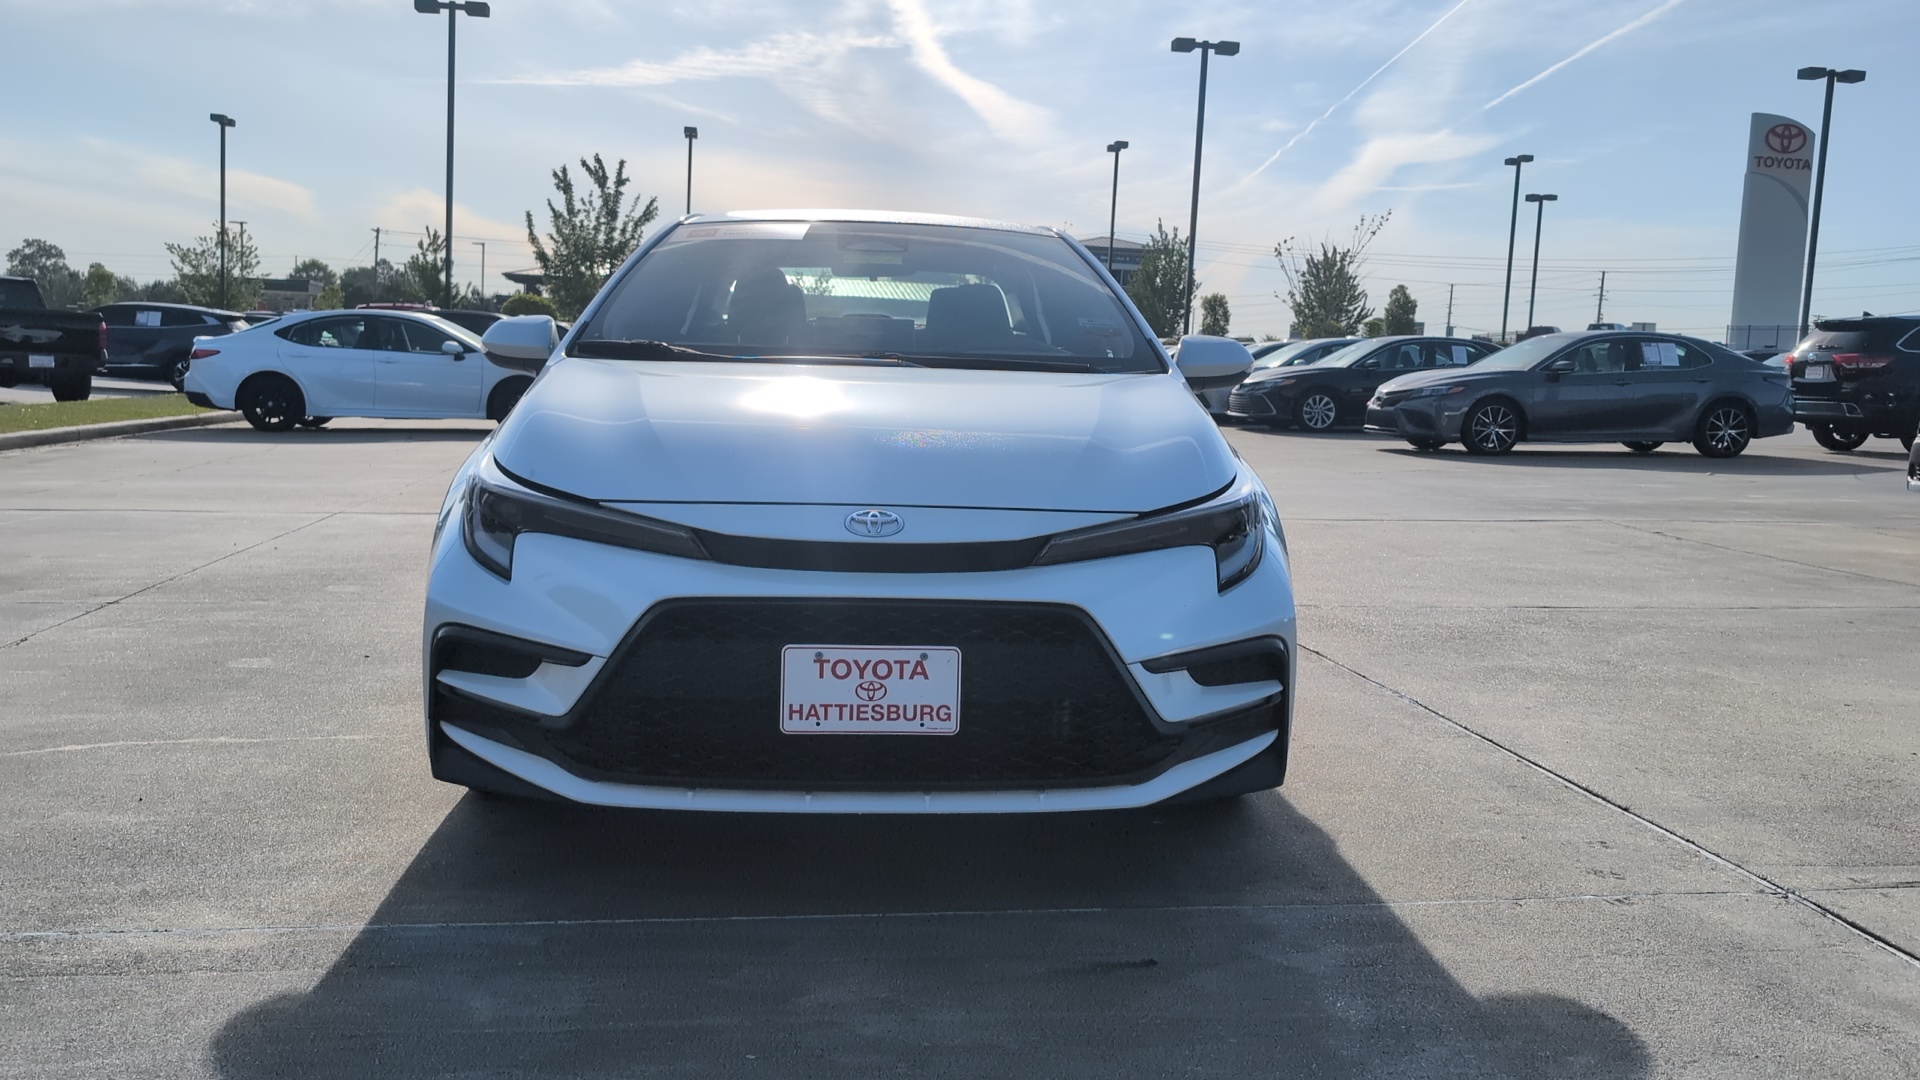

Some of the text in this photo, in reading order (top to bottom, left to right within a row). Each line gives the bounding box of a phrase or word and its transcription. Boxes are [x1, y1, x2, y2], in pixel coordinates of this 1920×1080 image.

[1755, 156, 1811, 170] TOYOTA
[813, 658, 930, 681] TOYOTA
[788, 703, 952, 722] HATTIESBURG
